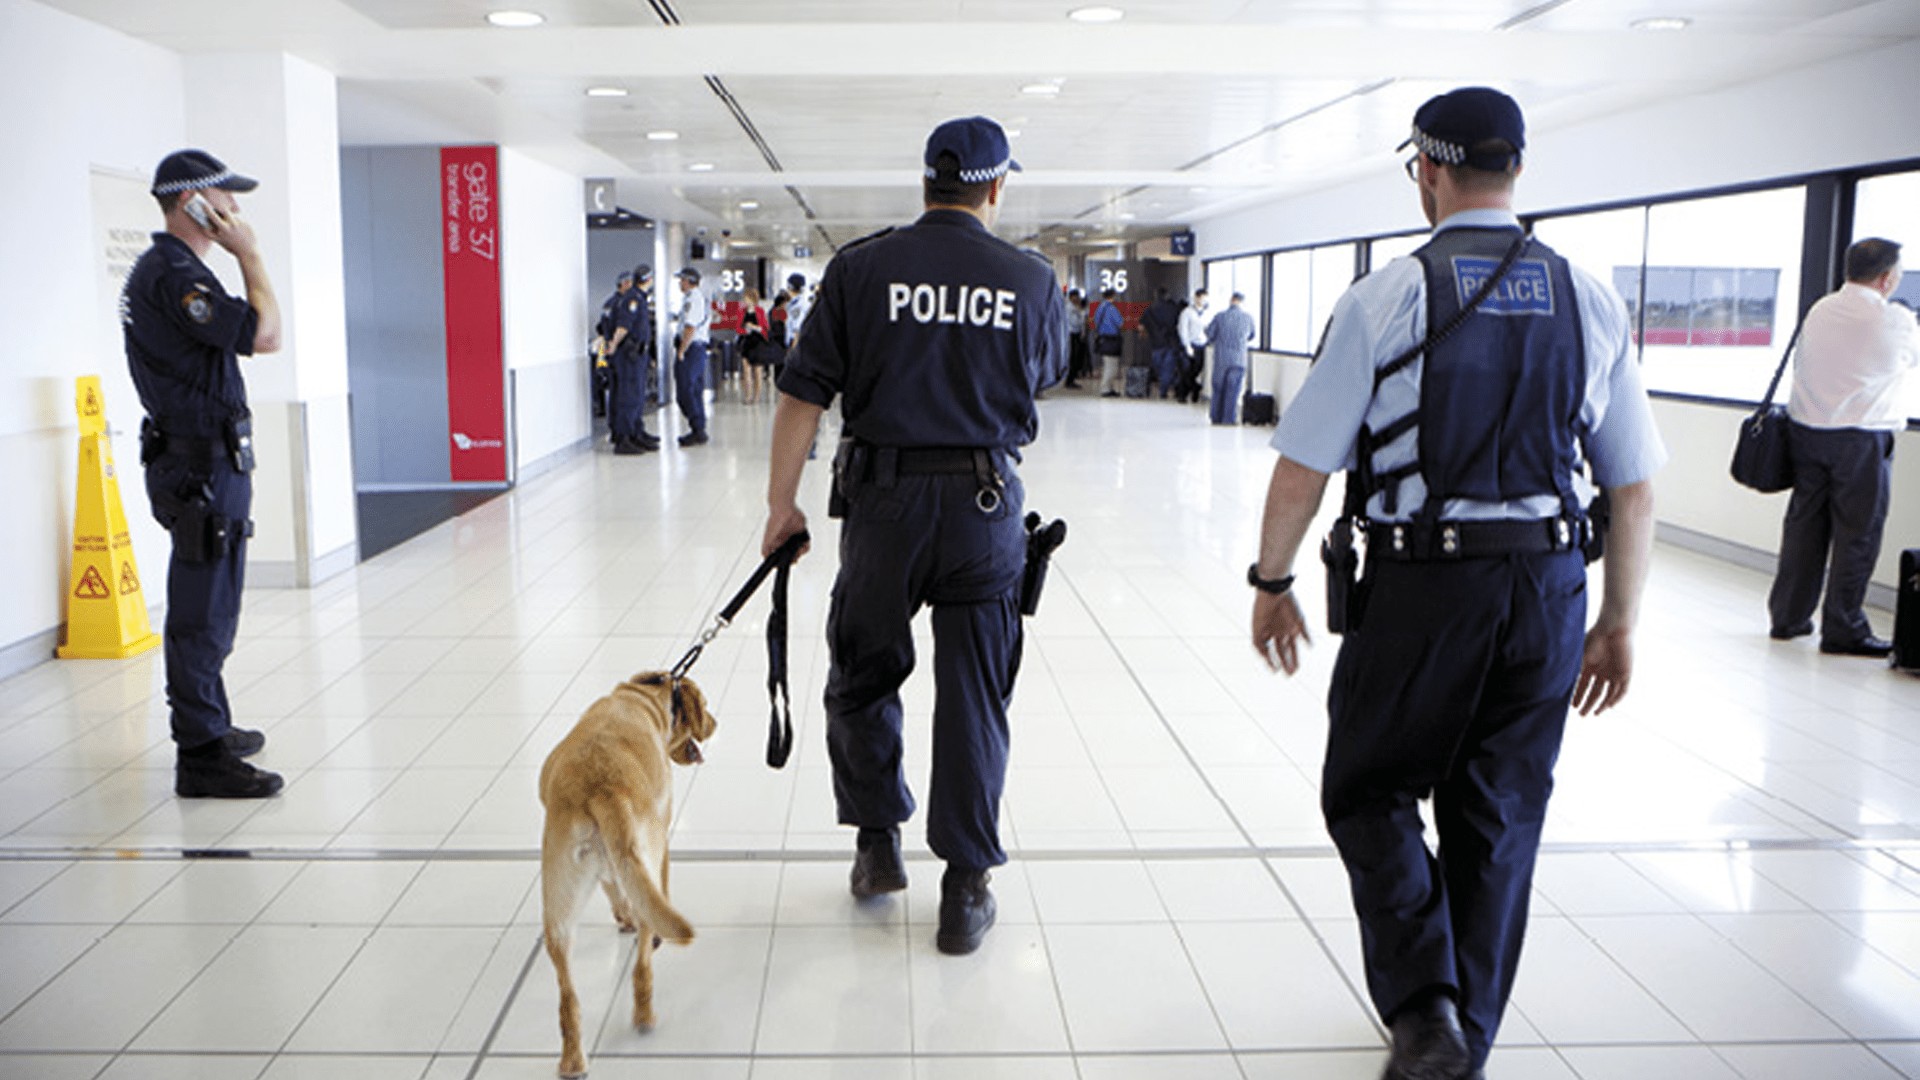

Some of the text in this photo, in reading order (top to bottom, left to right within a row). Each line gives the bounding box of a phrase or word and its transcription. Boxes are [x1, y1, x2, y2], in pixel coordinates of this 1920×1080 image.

[463, 162, 494, 260] gate 37
[721, 269, 745, 292] 35
[1100, 268, 1128, 293] 36
[889, 282, 1016, 330] POLICE
